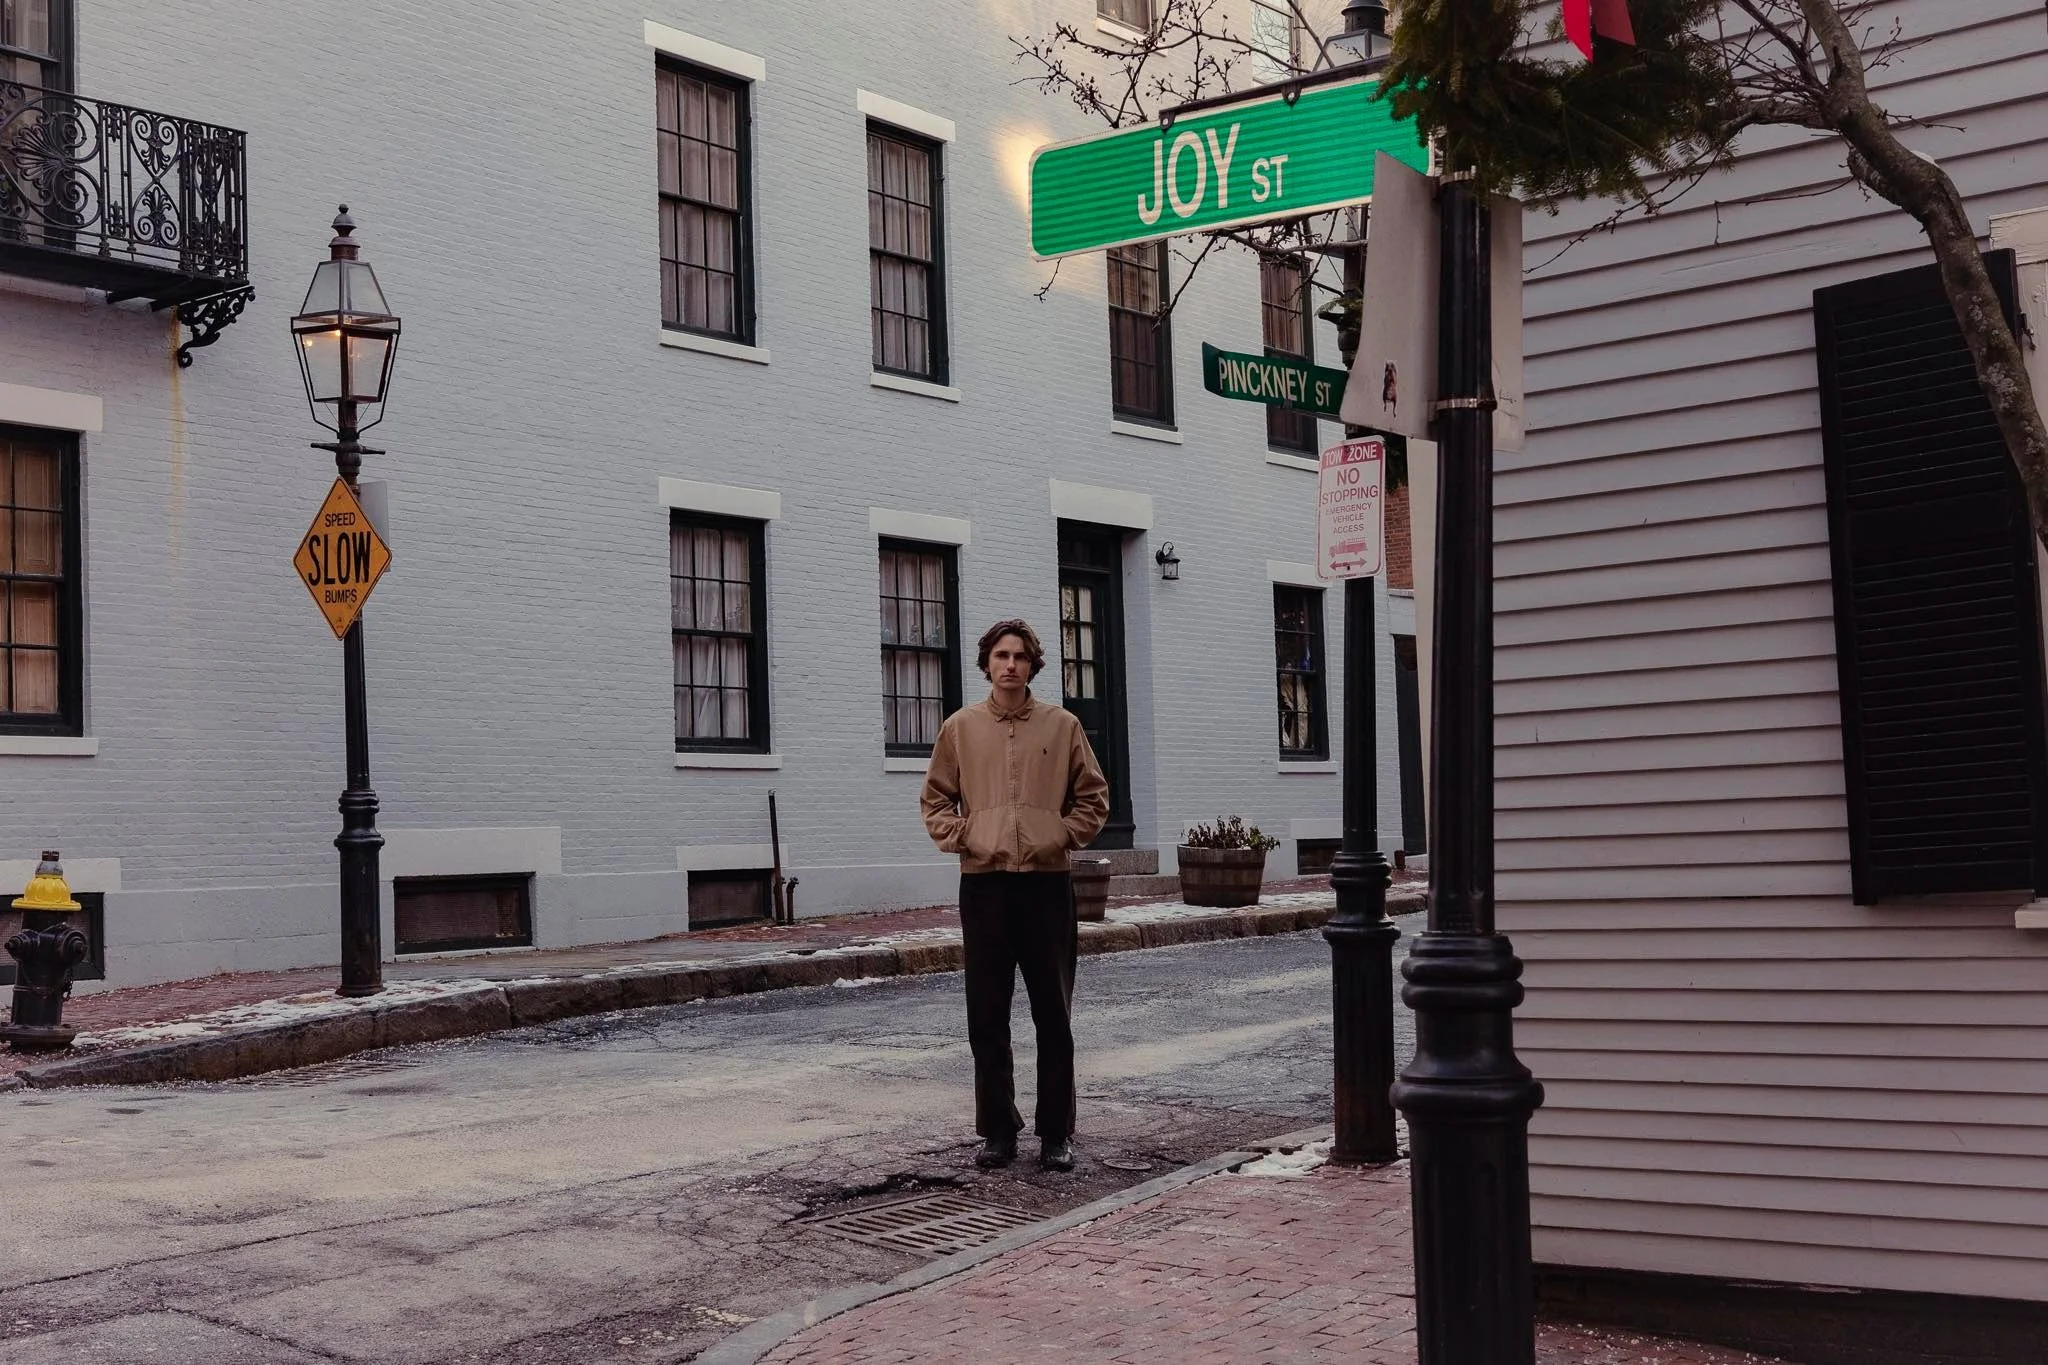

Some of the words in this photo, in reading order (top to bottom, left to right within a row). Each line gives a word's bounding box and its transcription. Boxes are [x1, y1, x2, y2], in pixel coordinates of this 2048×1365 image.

[1138, 123, 1240, 225] JOY
[1252, 154, 1289, 203] ST
[1218, 357, 1307, 403] PINCKNEY
[1315, 380, 1331, 407] ST
[1325, 448, 1343, 466] TOW
[1347, 444, 1377, 462] ZONE
[1336, 467, 1360, 486] NO
[1321, 484, 1379, 505] STOPPING
[324, 512, 356, 528] SPEED
[1333, 512, 1364, 523] VEHICLE
[1333, 524, 1365, 534] ACCESS
[308, 531, 372, 587] SLOW
[324, 588, 358, 604] BUMPS
